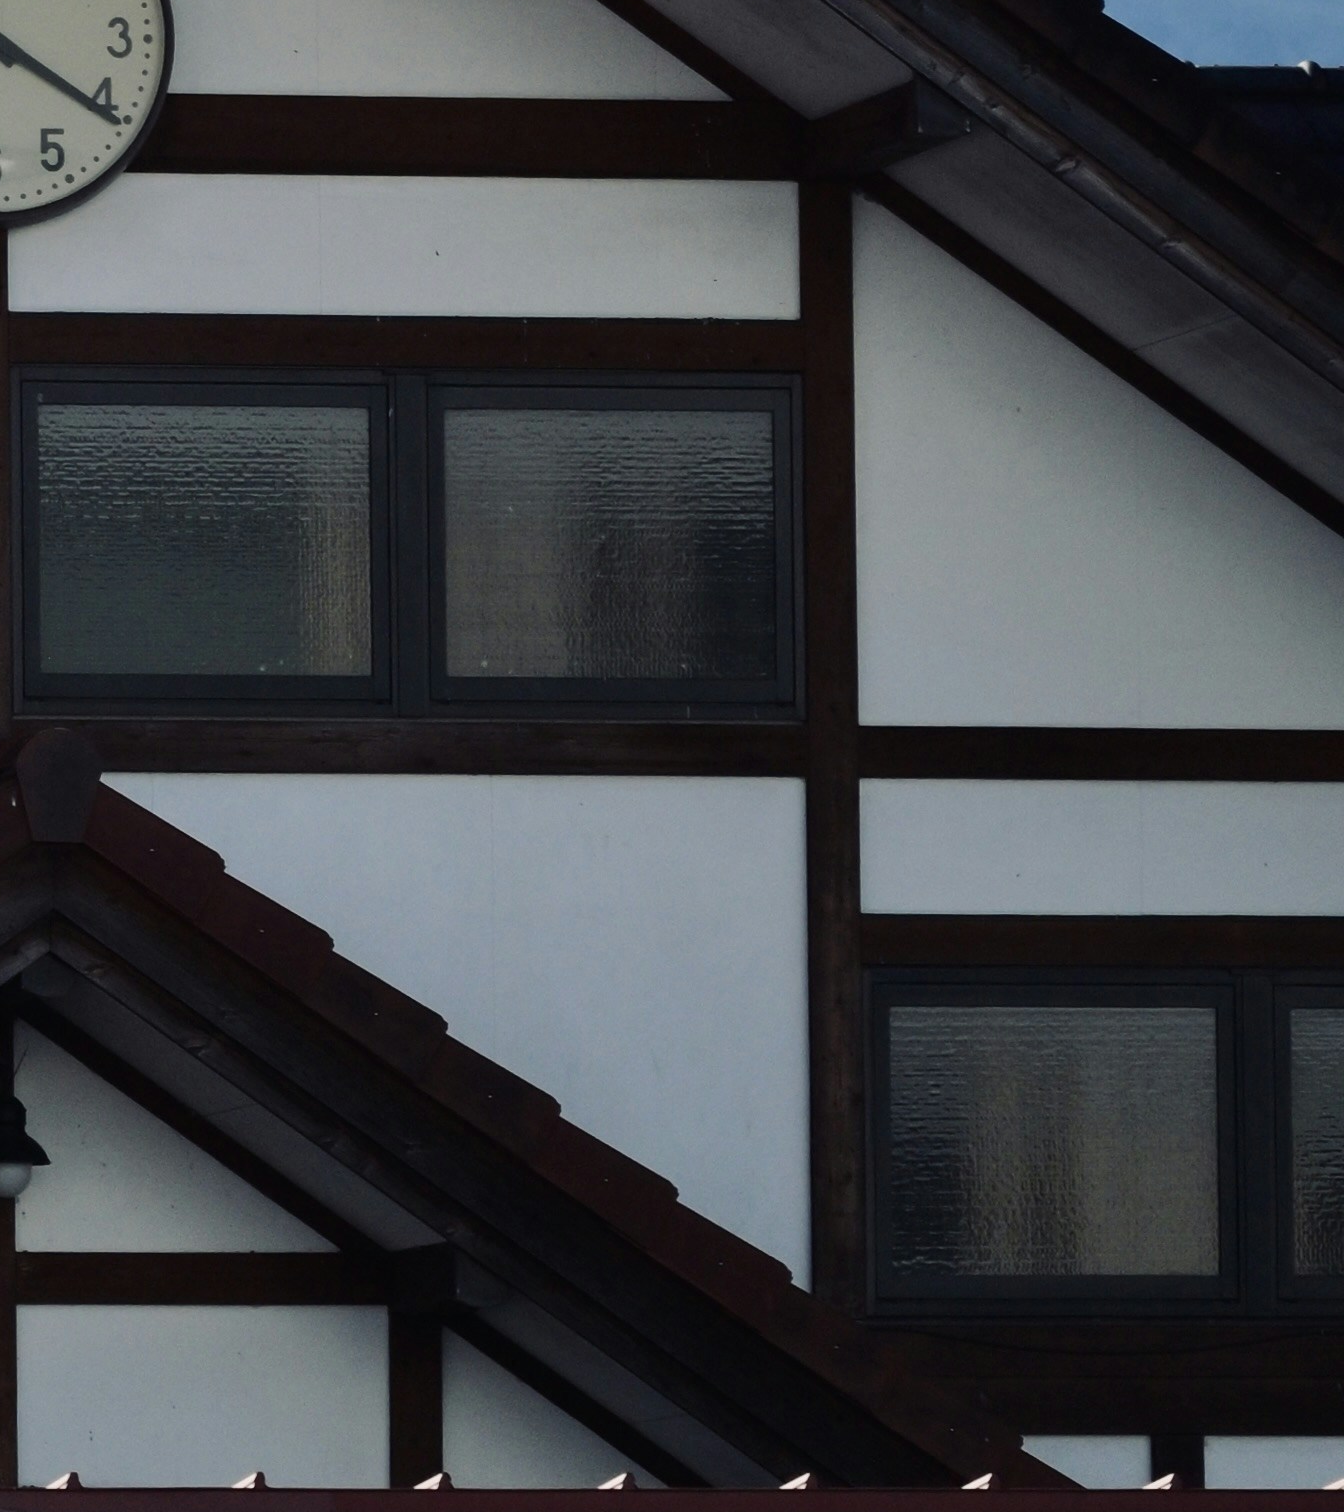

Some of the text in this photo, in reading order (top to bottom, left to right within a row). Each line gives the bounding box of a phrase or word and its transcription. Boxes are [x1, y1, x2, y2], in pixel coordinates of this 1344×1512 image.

[106, 17, 133, 59] 3
[90, 78, 120, 117] 4
[40, 128, 65, 172] 5
